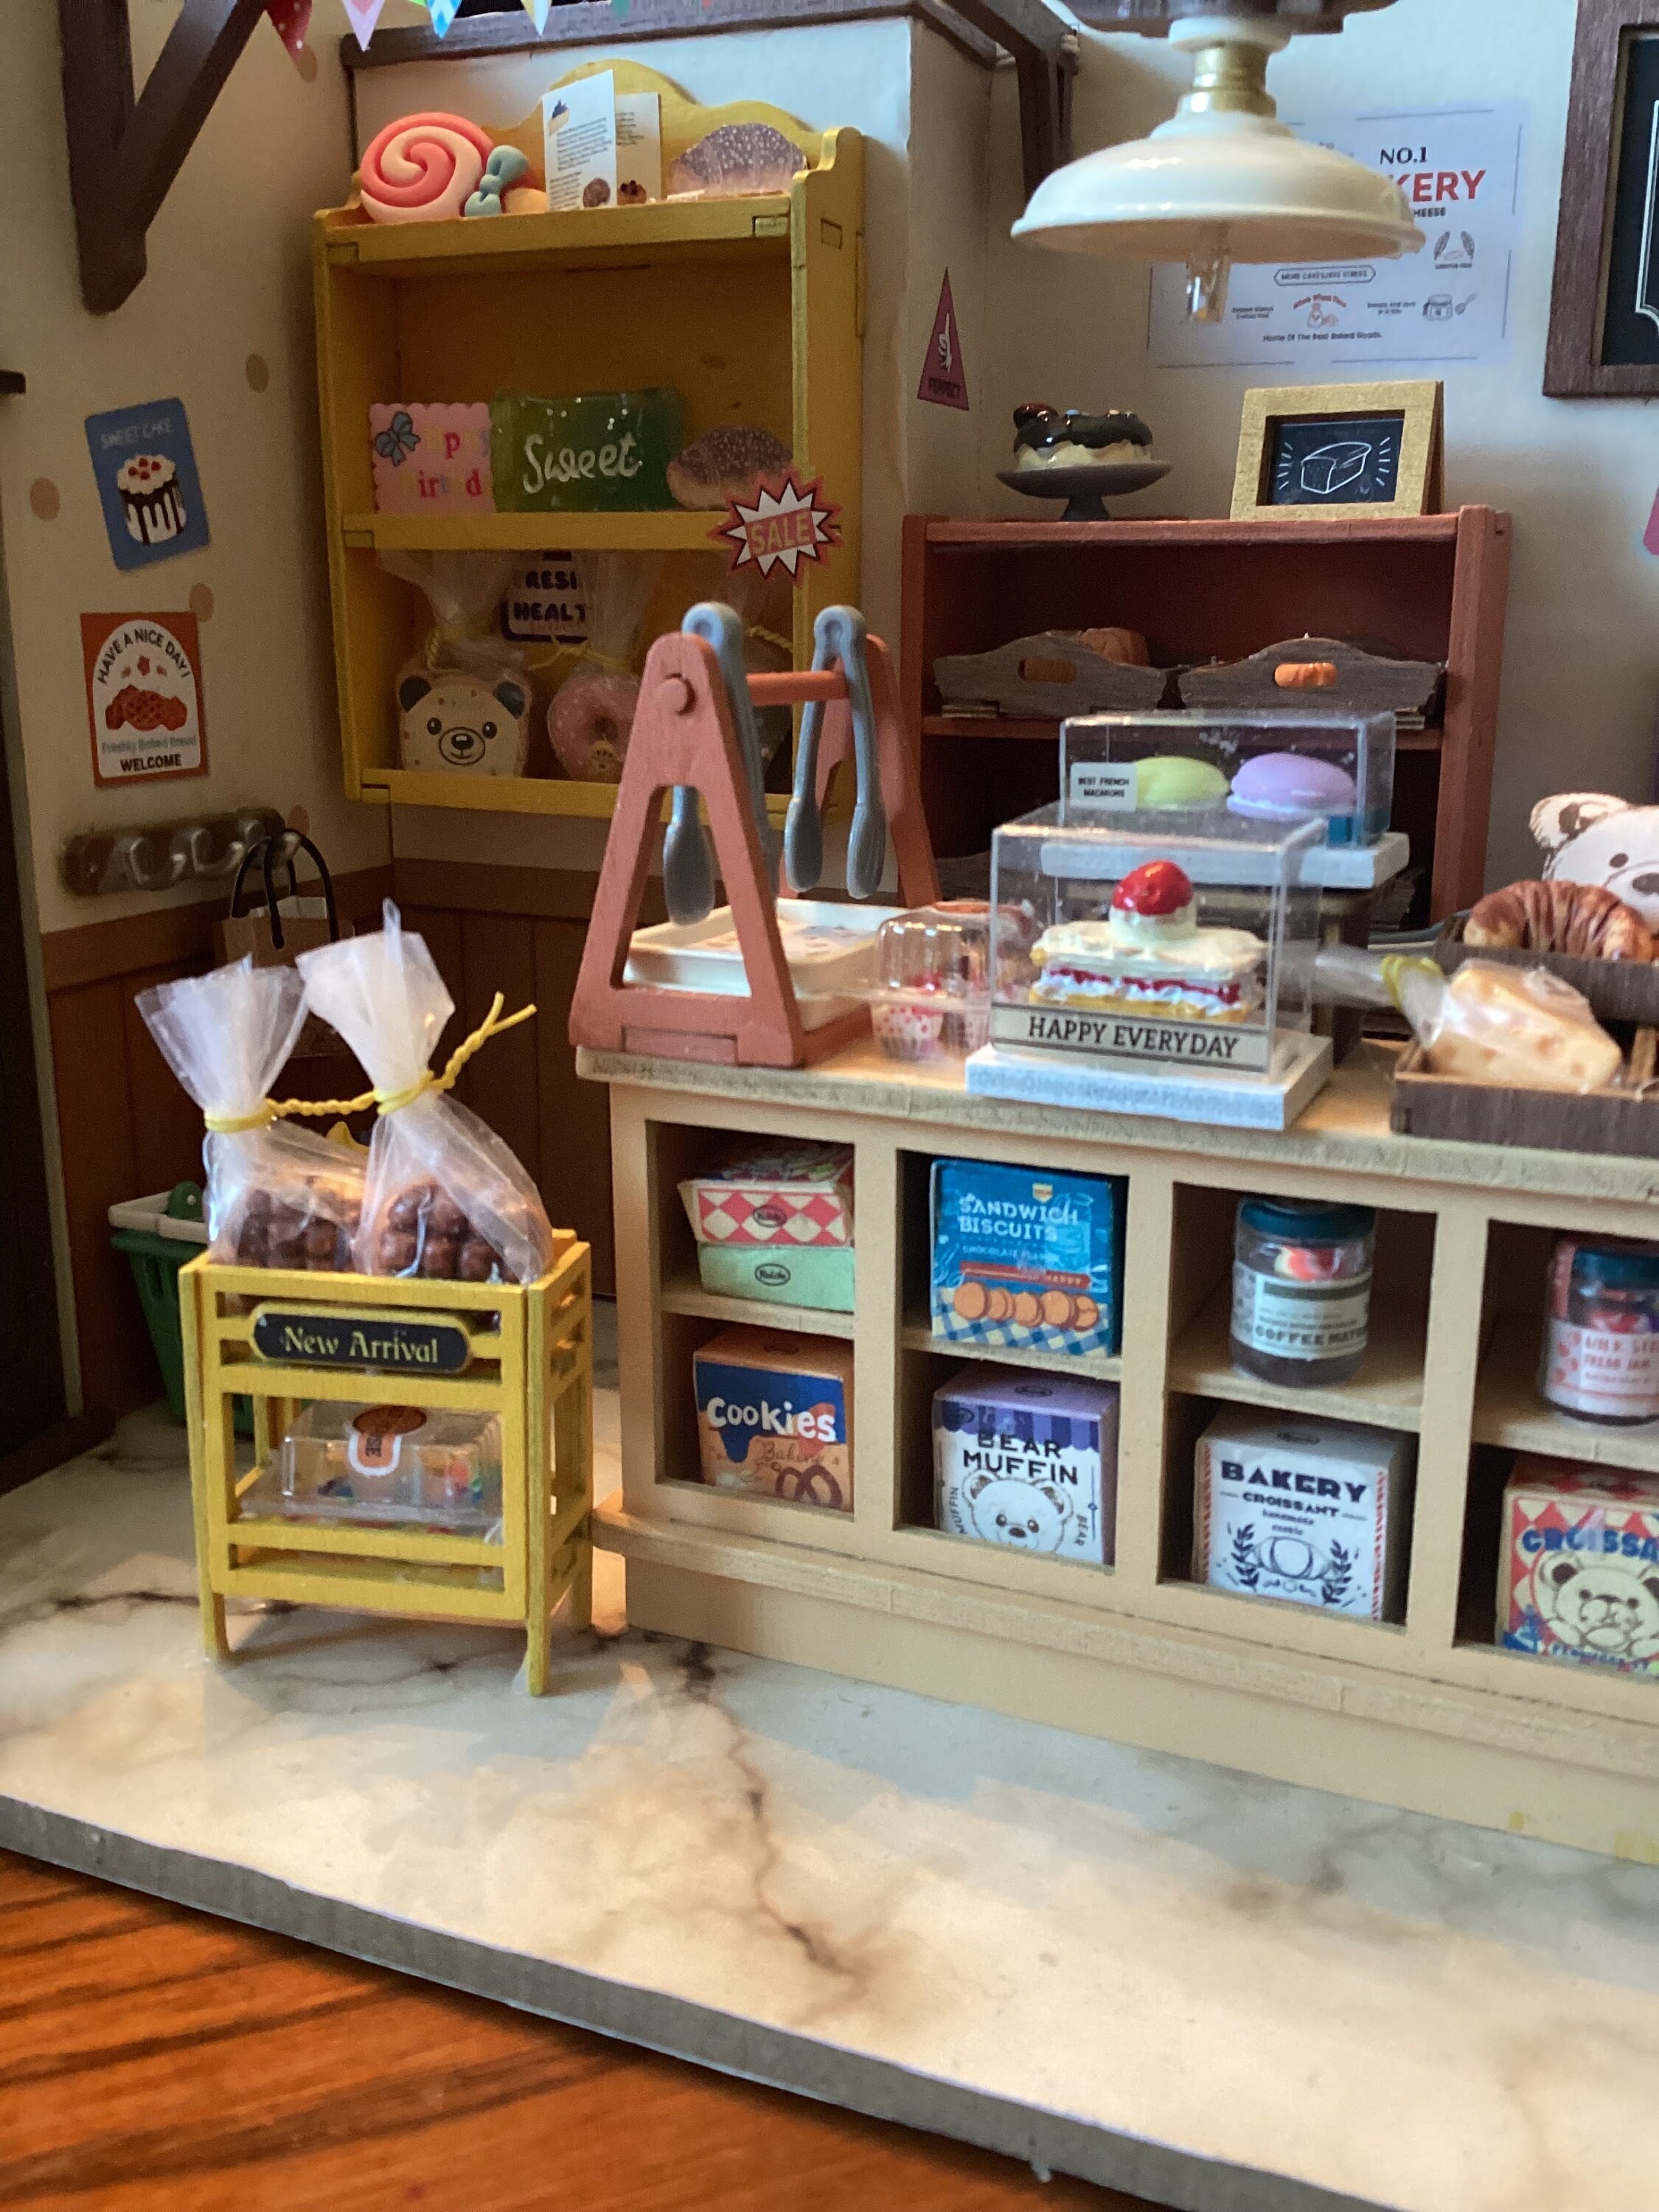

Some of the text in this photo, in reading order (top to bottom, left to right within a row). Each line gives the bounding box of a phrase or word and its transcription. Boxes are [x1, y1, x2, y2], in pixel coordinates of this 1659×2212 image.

[1380, 146, 1427, 165] NO.1
[523, 431, 643, 494] Sweet
[751, 511, 812, 557] SALE
[97, 628, 190, 685] HAVE A NICE DAY!
[120, 754, 182, 772] WELCOME
[1029, 1016, 1239, 1059] HAPPY EVERYDAY
[959, 1192, 1079, 1226] SANDWICH
[959, 1214, 1059, 1243] BISCUITS
[285, 1326, 438, 1363] New Arrival
[1256, 1325, 1325, 1346] COFFEE
[706, 1397, 837, 1443] Cookies
[978, 1429, 1061, 1459] BEAR
[963, 1450, 1078, 1485] MUFFIN
[1221, 1461, 1366, 1503] BAKERY
[1242, 1492, 1340, 1517] CROISSANT
[1074, 1514, 1088, 1546] BEAR
